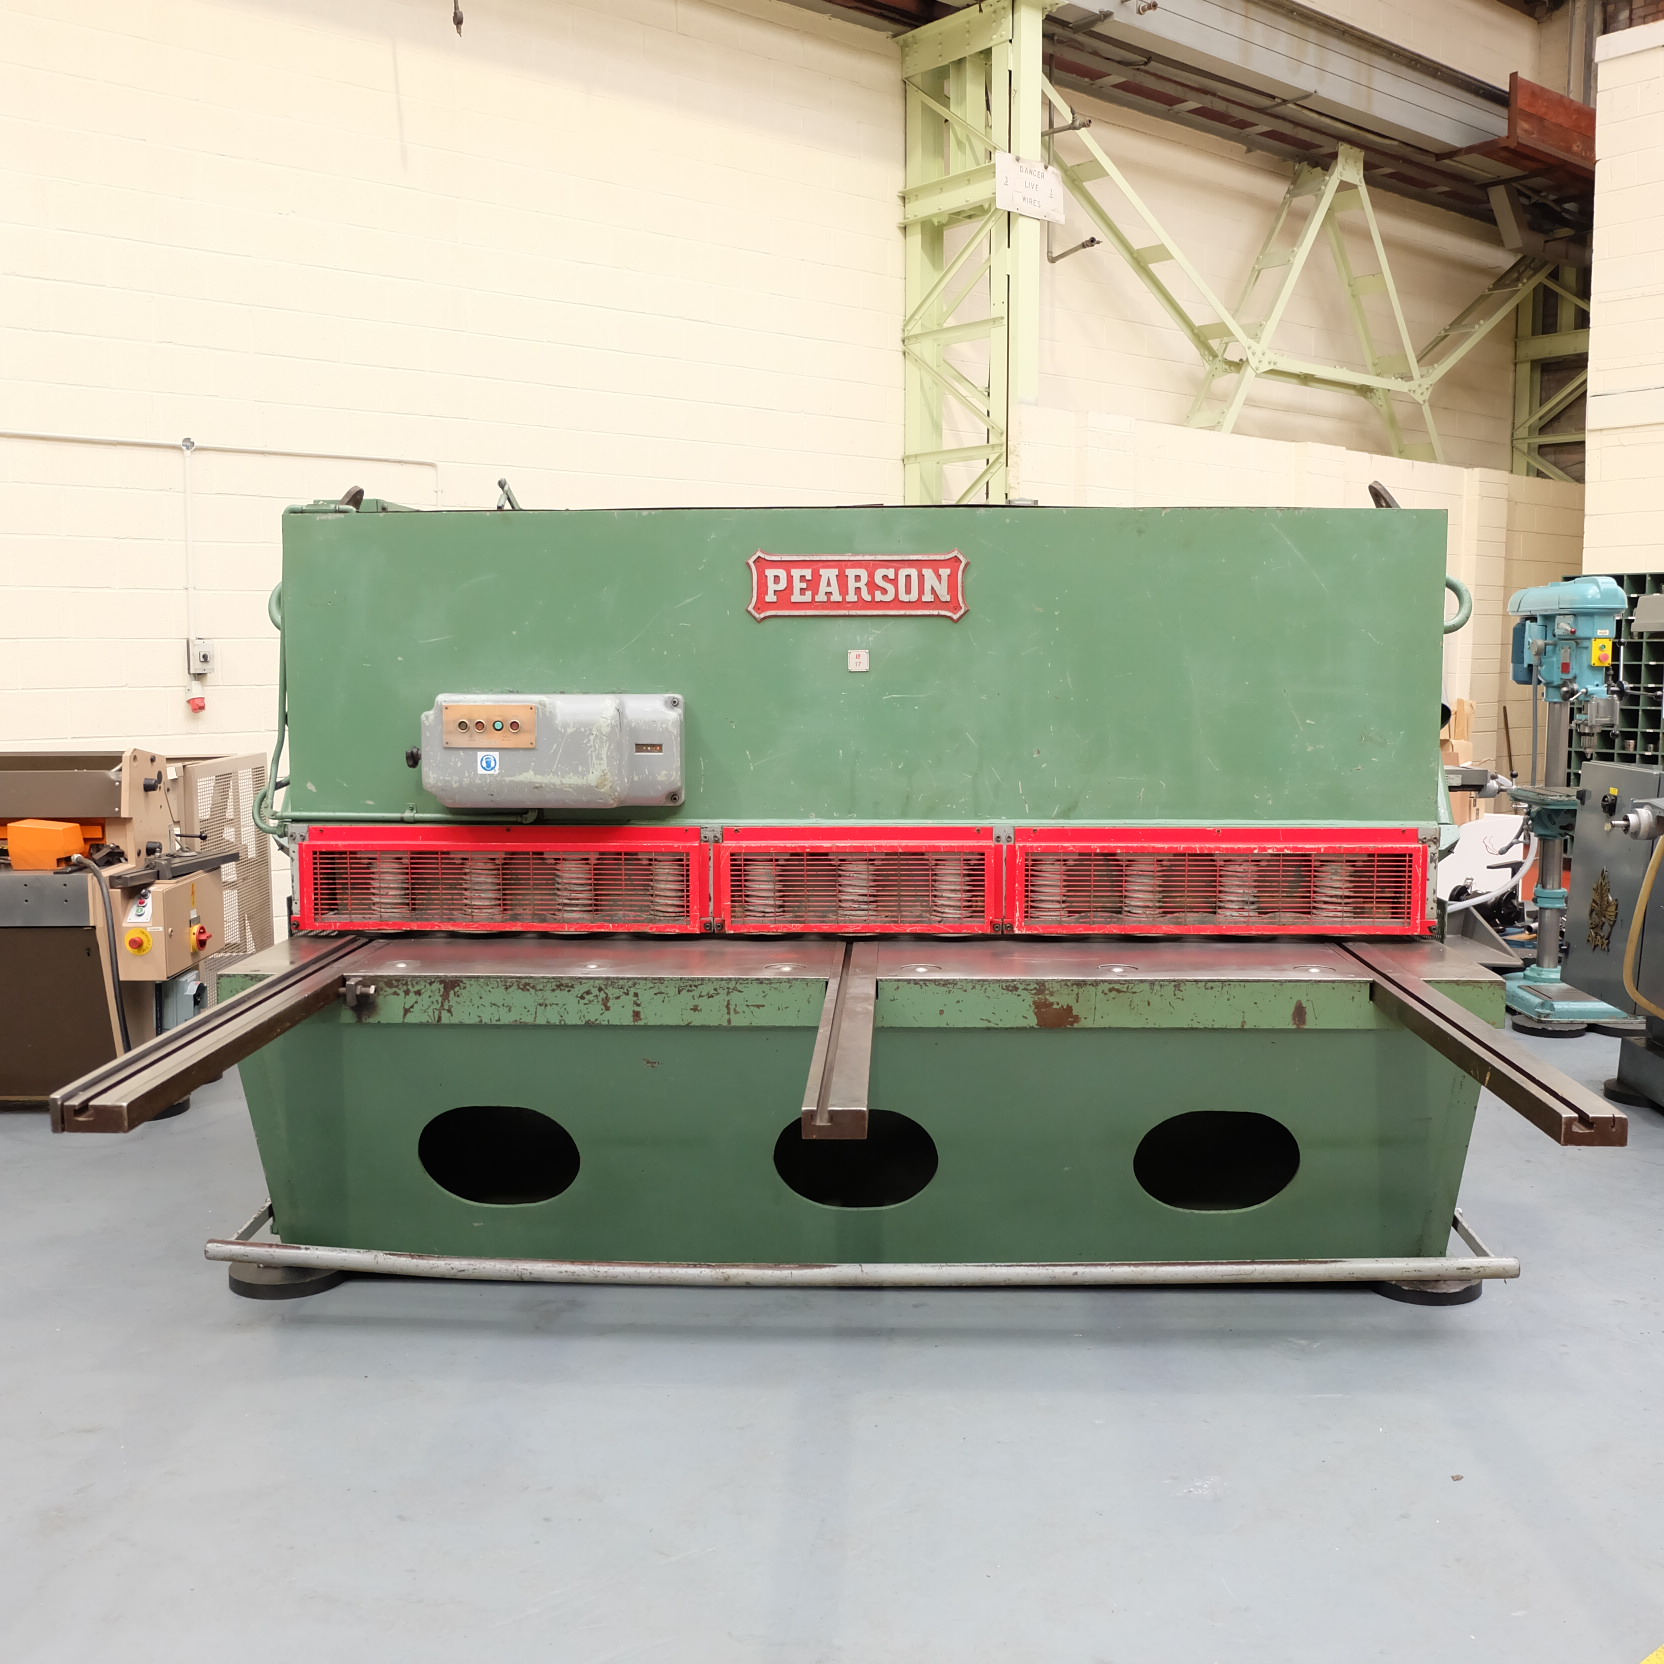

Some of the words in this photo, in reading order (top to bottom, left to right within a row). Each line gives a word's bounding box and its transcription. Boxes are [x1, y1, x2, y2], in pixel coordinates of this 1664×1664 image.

[1024, 180, 1039, 192] LIVE
[1021, 195, 1041, 208] WIRES
[764, 568, 951, 603] PEARSON
[1586, 932, 1610, 952] AJAX
